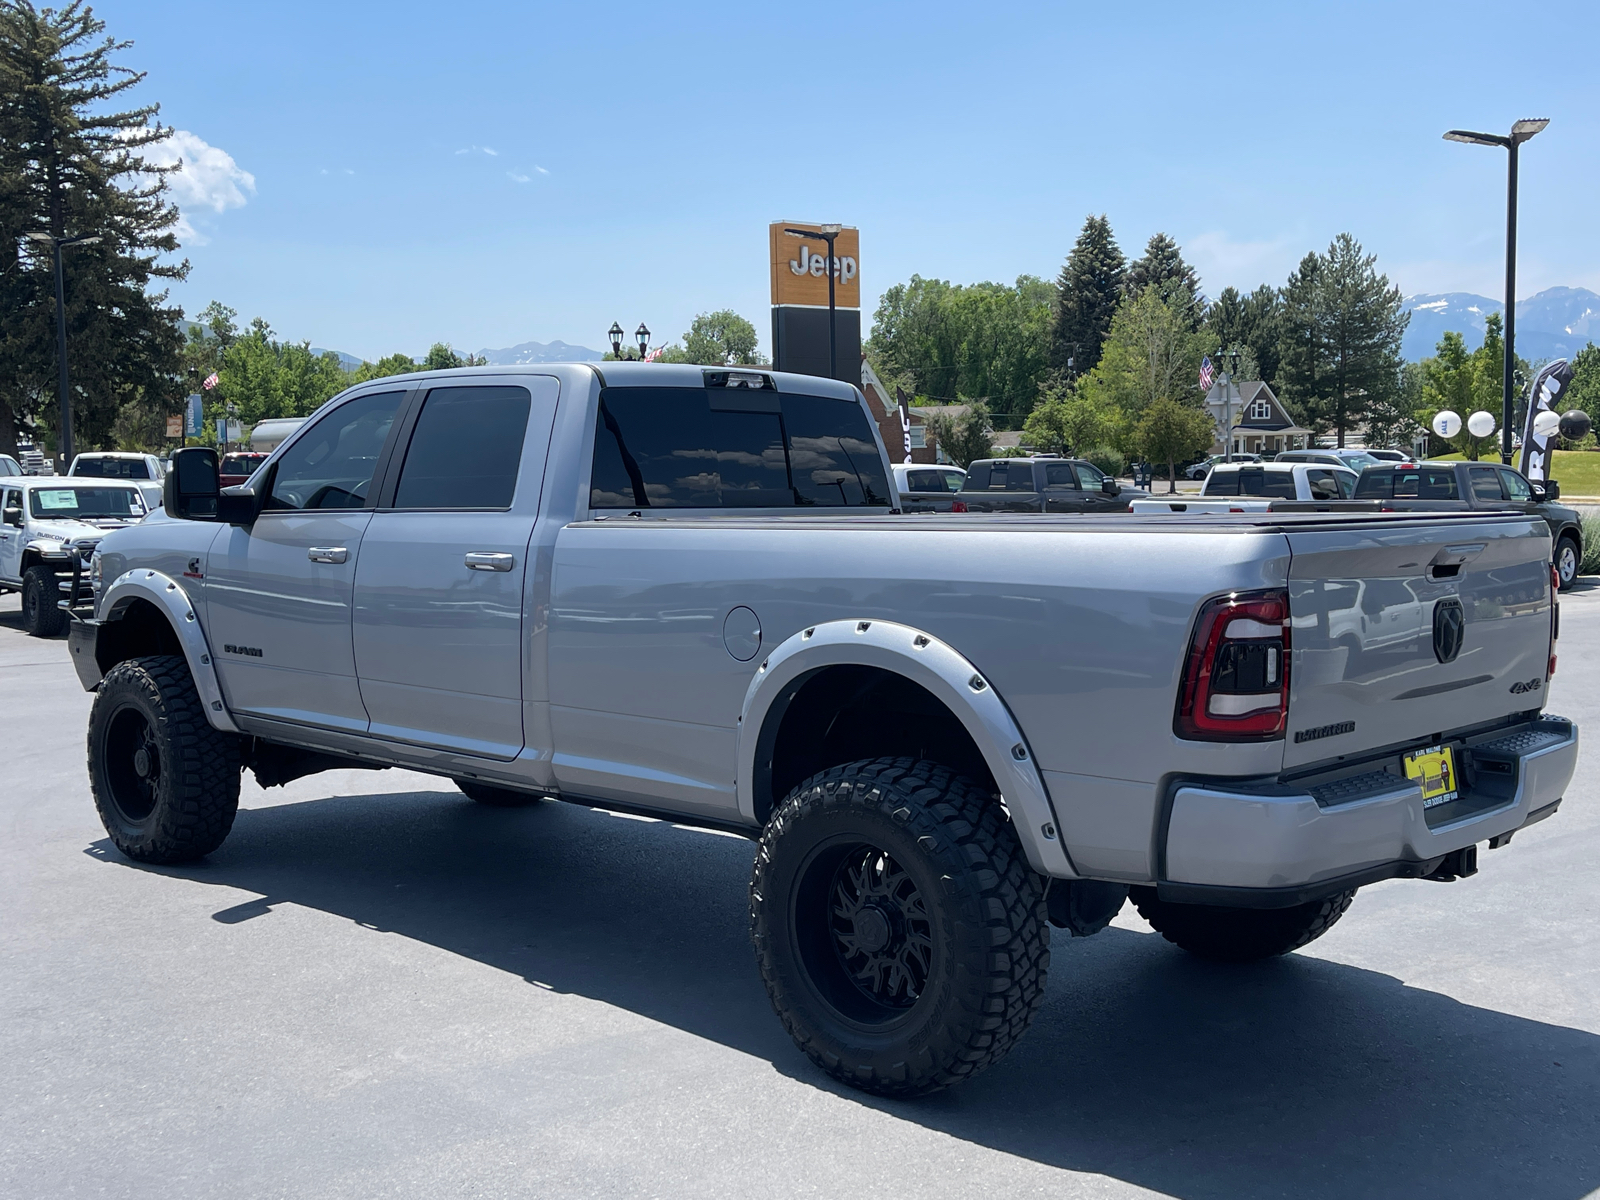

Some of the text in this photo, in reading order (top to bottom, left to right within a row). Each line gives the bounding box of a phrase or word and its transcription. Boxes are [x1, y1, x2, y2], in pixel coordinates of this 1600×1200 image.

[789, 245, 857, 285] Jeep
[37, 531, 66, 541] RUBICON
[224, 644, 263, 658] RAM
[1294, 720, 1356, 743] LARAMIE
